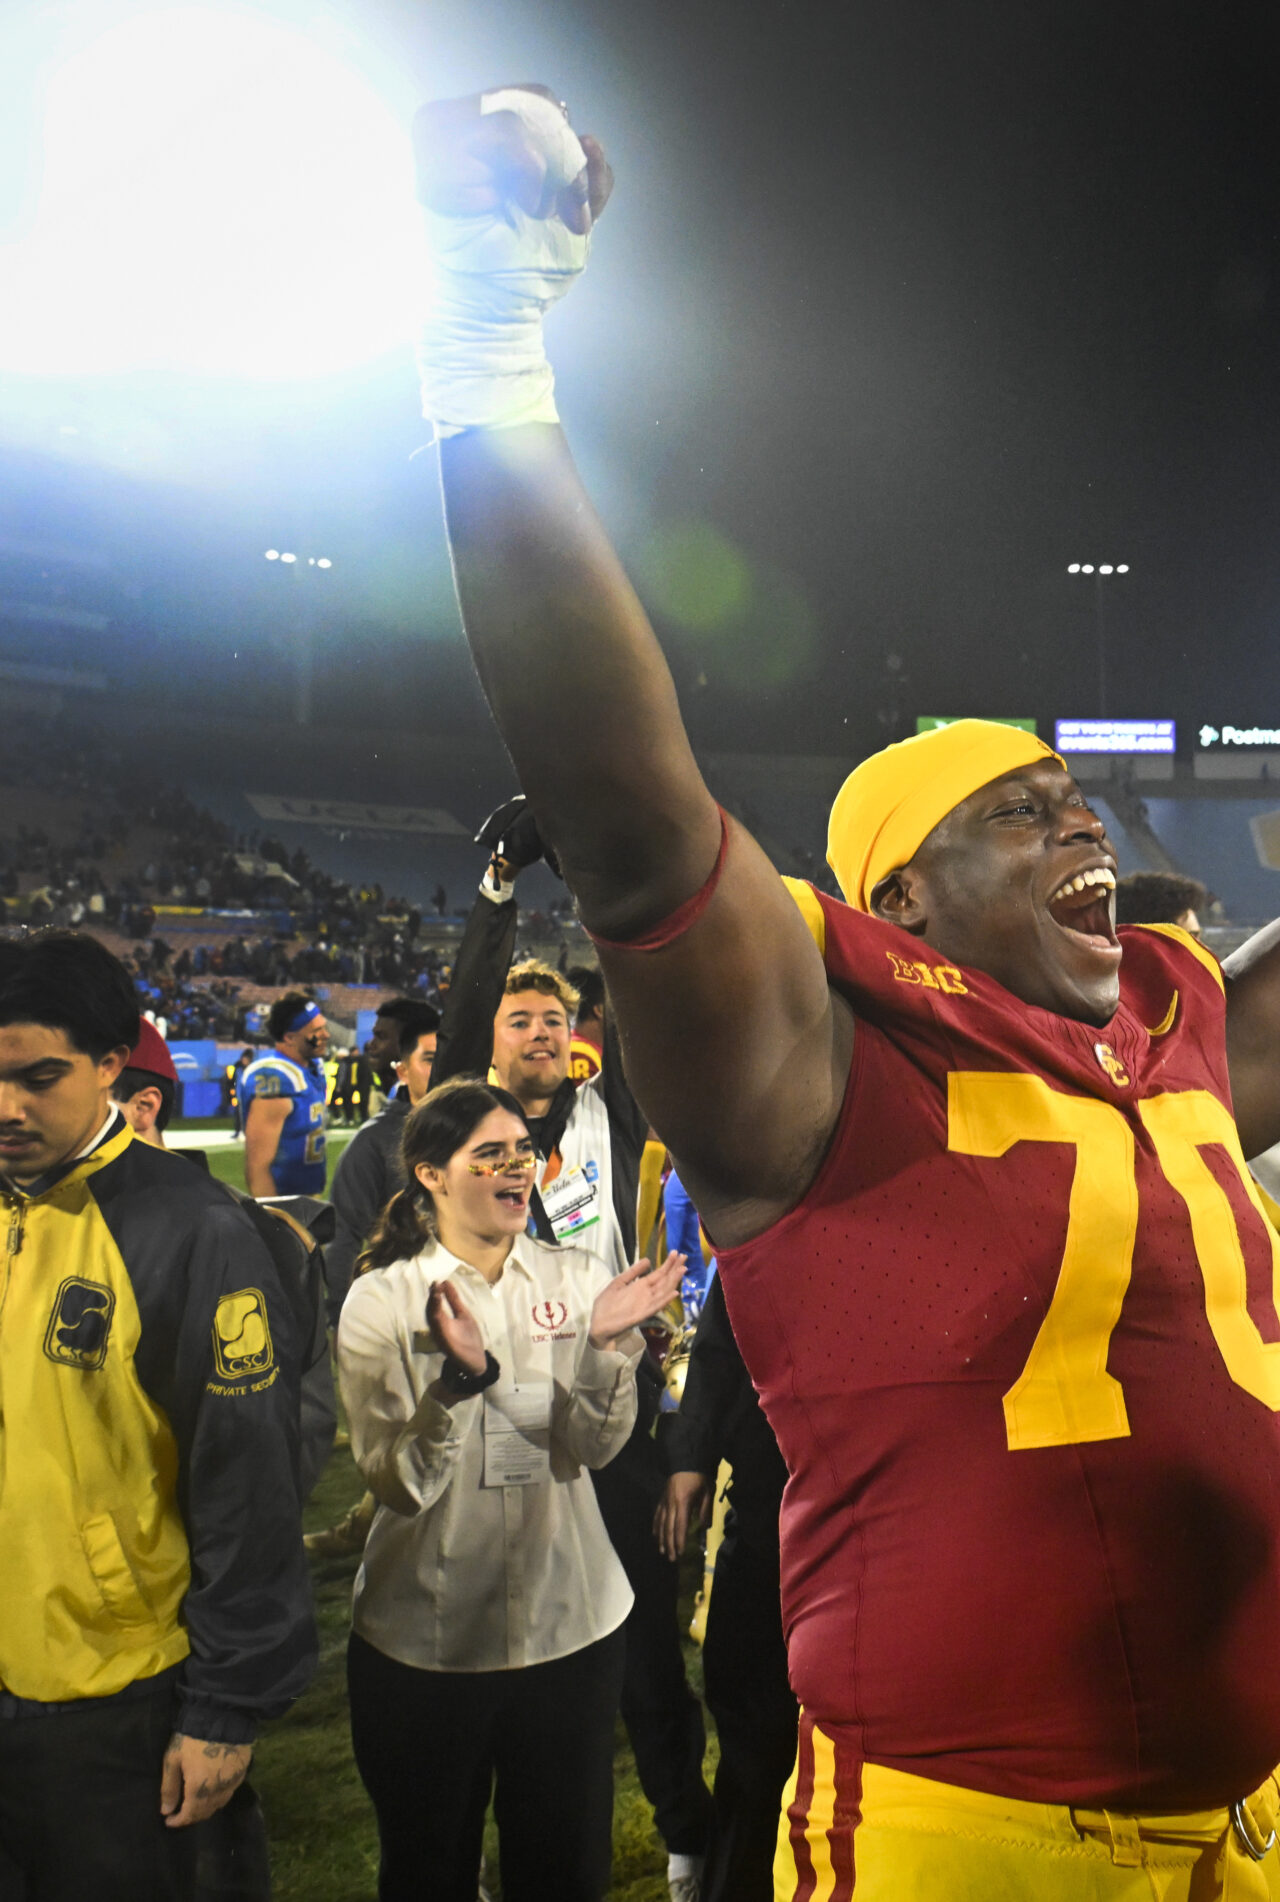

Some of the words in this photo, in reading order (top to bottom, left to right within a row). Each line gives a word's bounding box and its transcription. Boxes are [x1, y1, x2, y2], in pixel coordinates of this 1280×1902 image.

[254, 1075, 281, 1096] 20
[229, 1353, 263, 1371] CSC
[206, 1382, 248, 1397] PRIVATE
